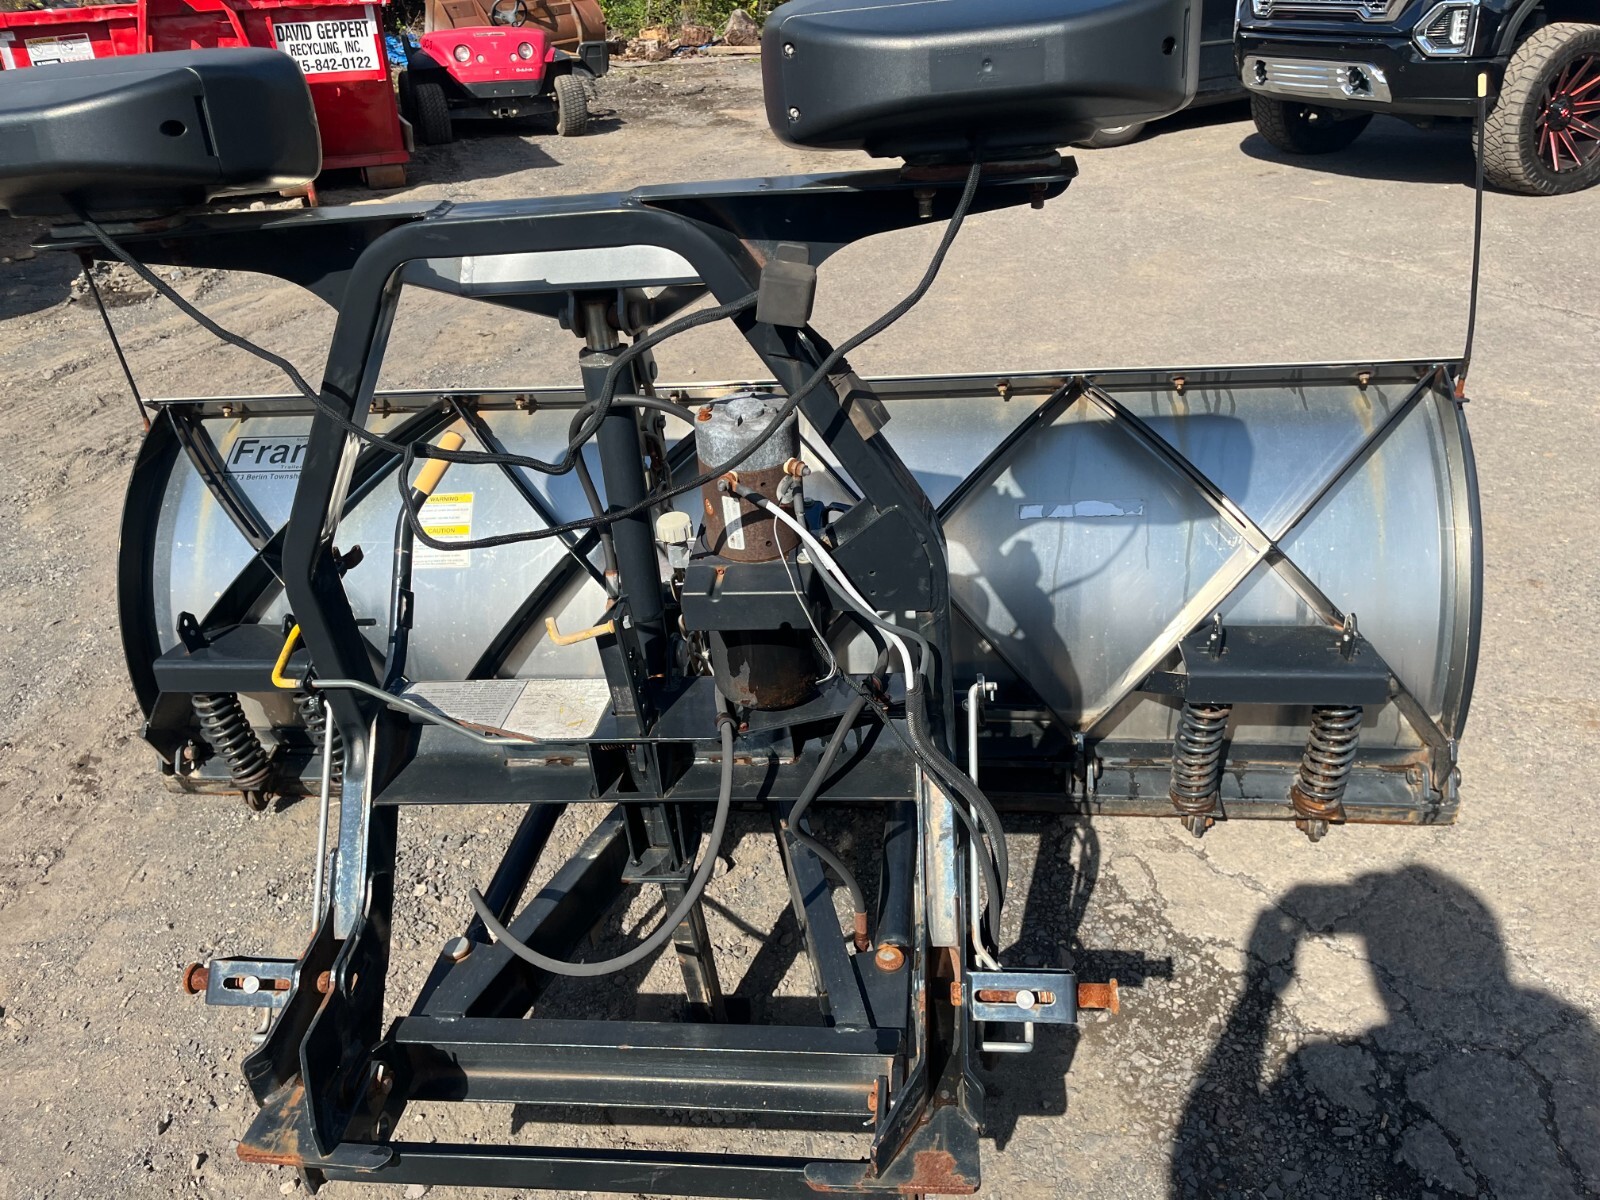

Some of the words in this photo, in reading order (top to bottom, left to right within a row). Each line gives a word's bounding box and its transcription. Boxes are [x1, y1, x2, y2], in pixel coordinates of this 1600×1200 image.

[275, 23, 312, 42] DAVID
[316, 20, 369, 40] GEPPERT
[289, 42, 343, 56] RECYCLING,
[345, 40, 364, 53] INC.
